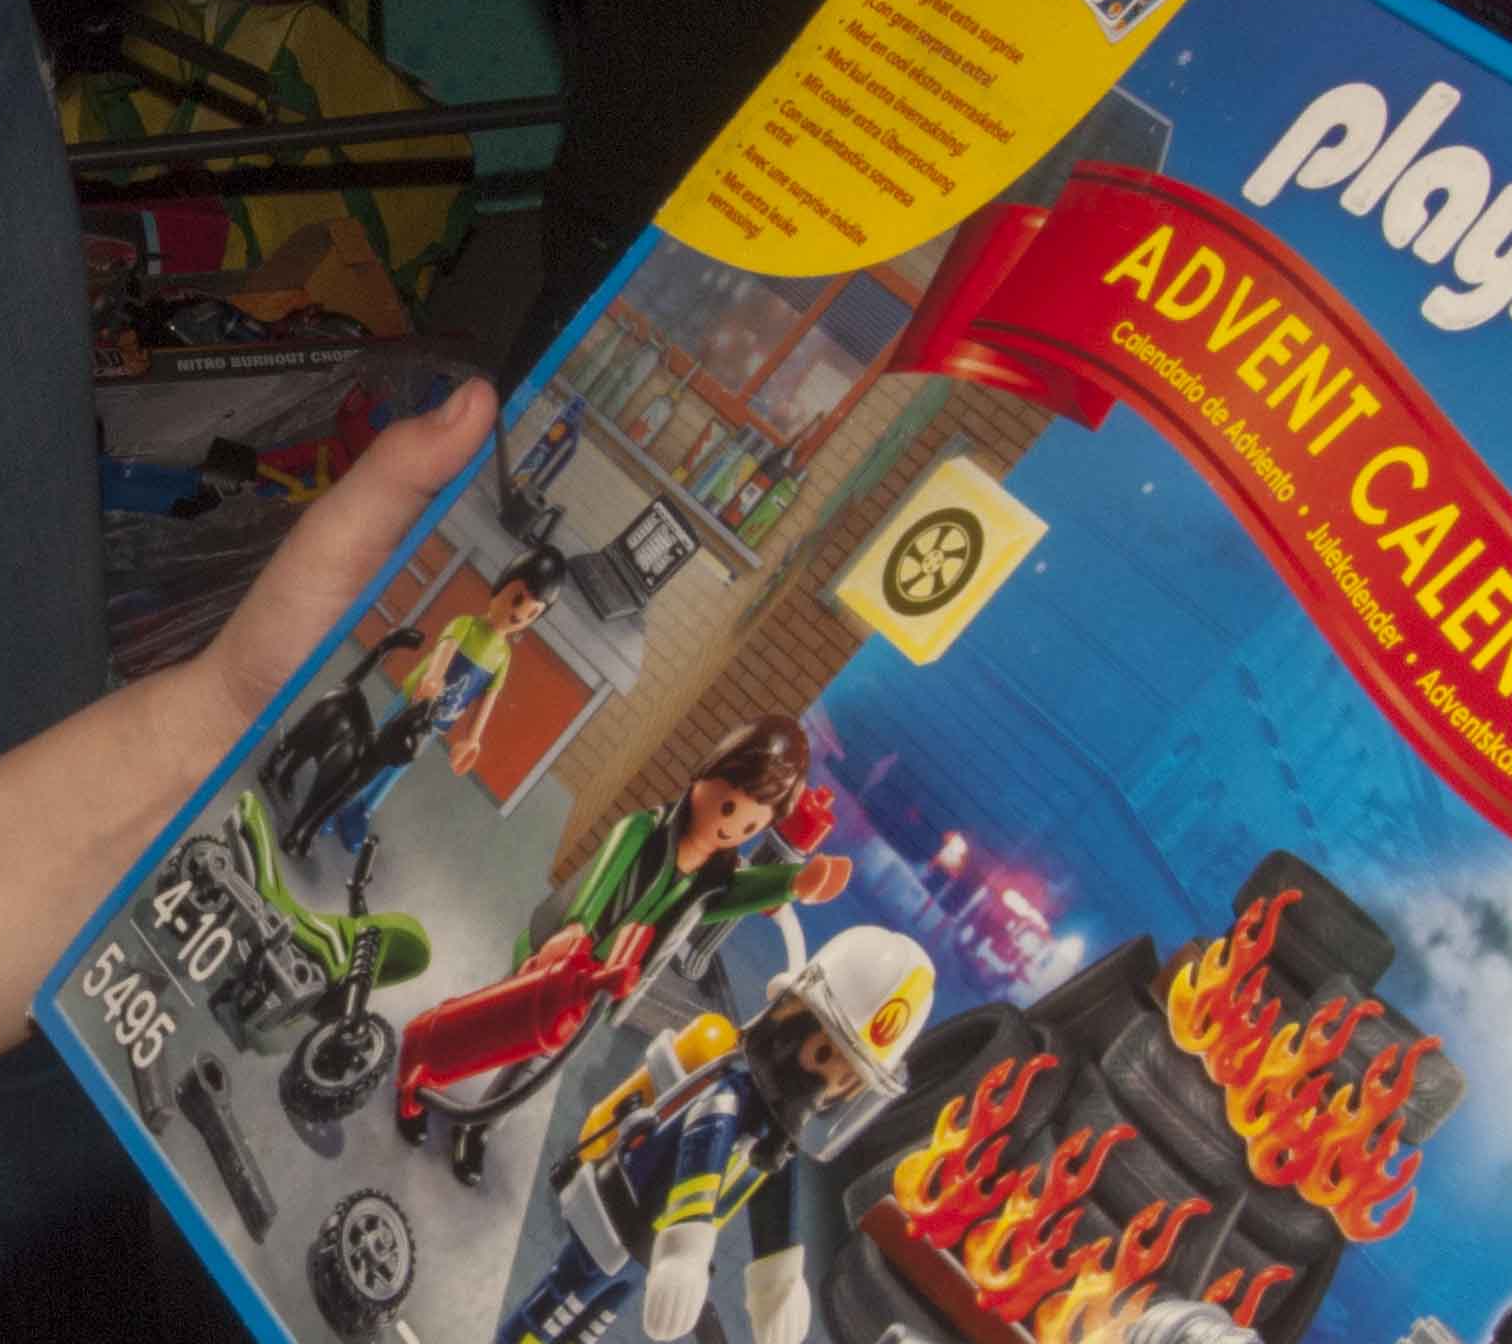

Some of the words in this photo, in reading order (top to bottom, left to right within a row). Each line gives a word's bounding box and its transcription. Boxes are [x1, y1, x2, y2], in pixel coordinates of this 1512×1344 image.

[845, 19, 876, 47] Med
[884, 51, 914, 73] cool
[915, 29, 963, 67] sorpresa
[949, 9, 980, 35] extra
[976, 28, 1024, 64] surprise
[800, 72, 824, 96] Mit
[819, 89, 856, 118] cooler
[851, 113, 882, 139] extra
[823, 46, 854, 73] Med
[865, 79, 896, 106] extra
[778, 99, 803, 123] Con
[872, 169, 915, 205] sorpresa
[740, 189, 770, 216] extra
[766, 165, 791, 187] une
[786, 180, 831, 218] surprise
[1103, 224, 1381, 456] ADVENT
[1111, 320, 1206, 403] Calendario
[1200, 396, 1230, 427] de
[1222, 418, 1295, 502] Adviento
[1305, 522, 1403, 649] Julekalender
[151, 881, 234, 983] 4-10
[81, 942, 177, 1071] 5495
